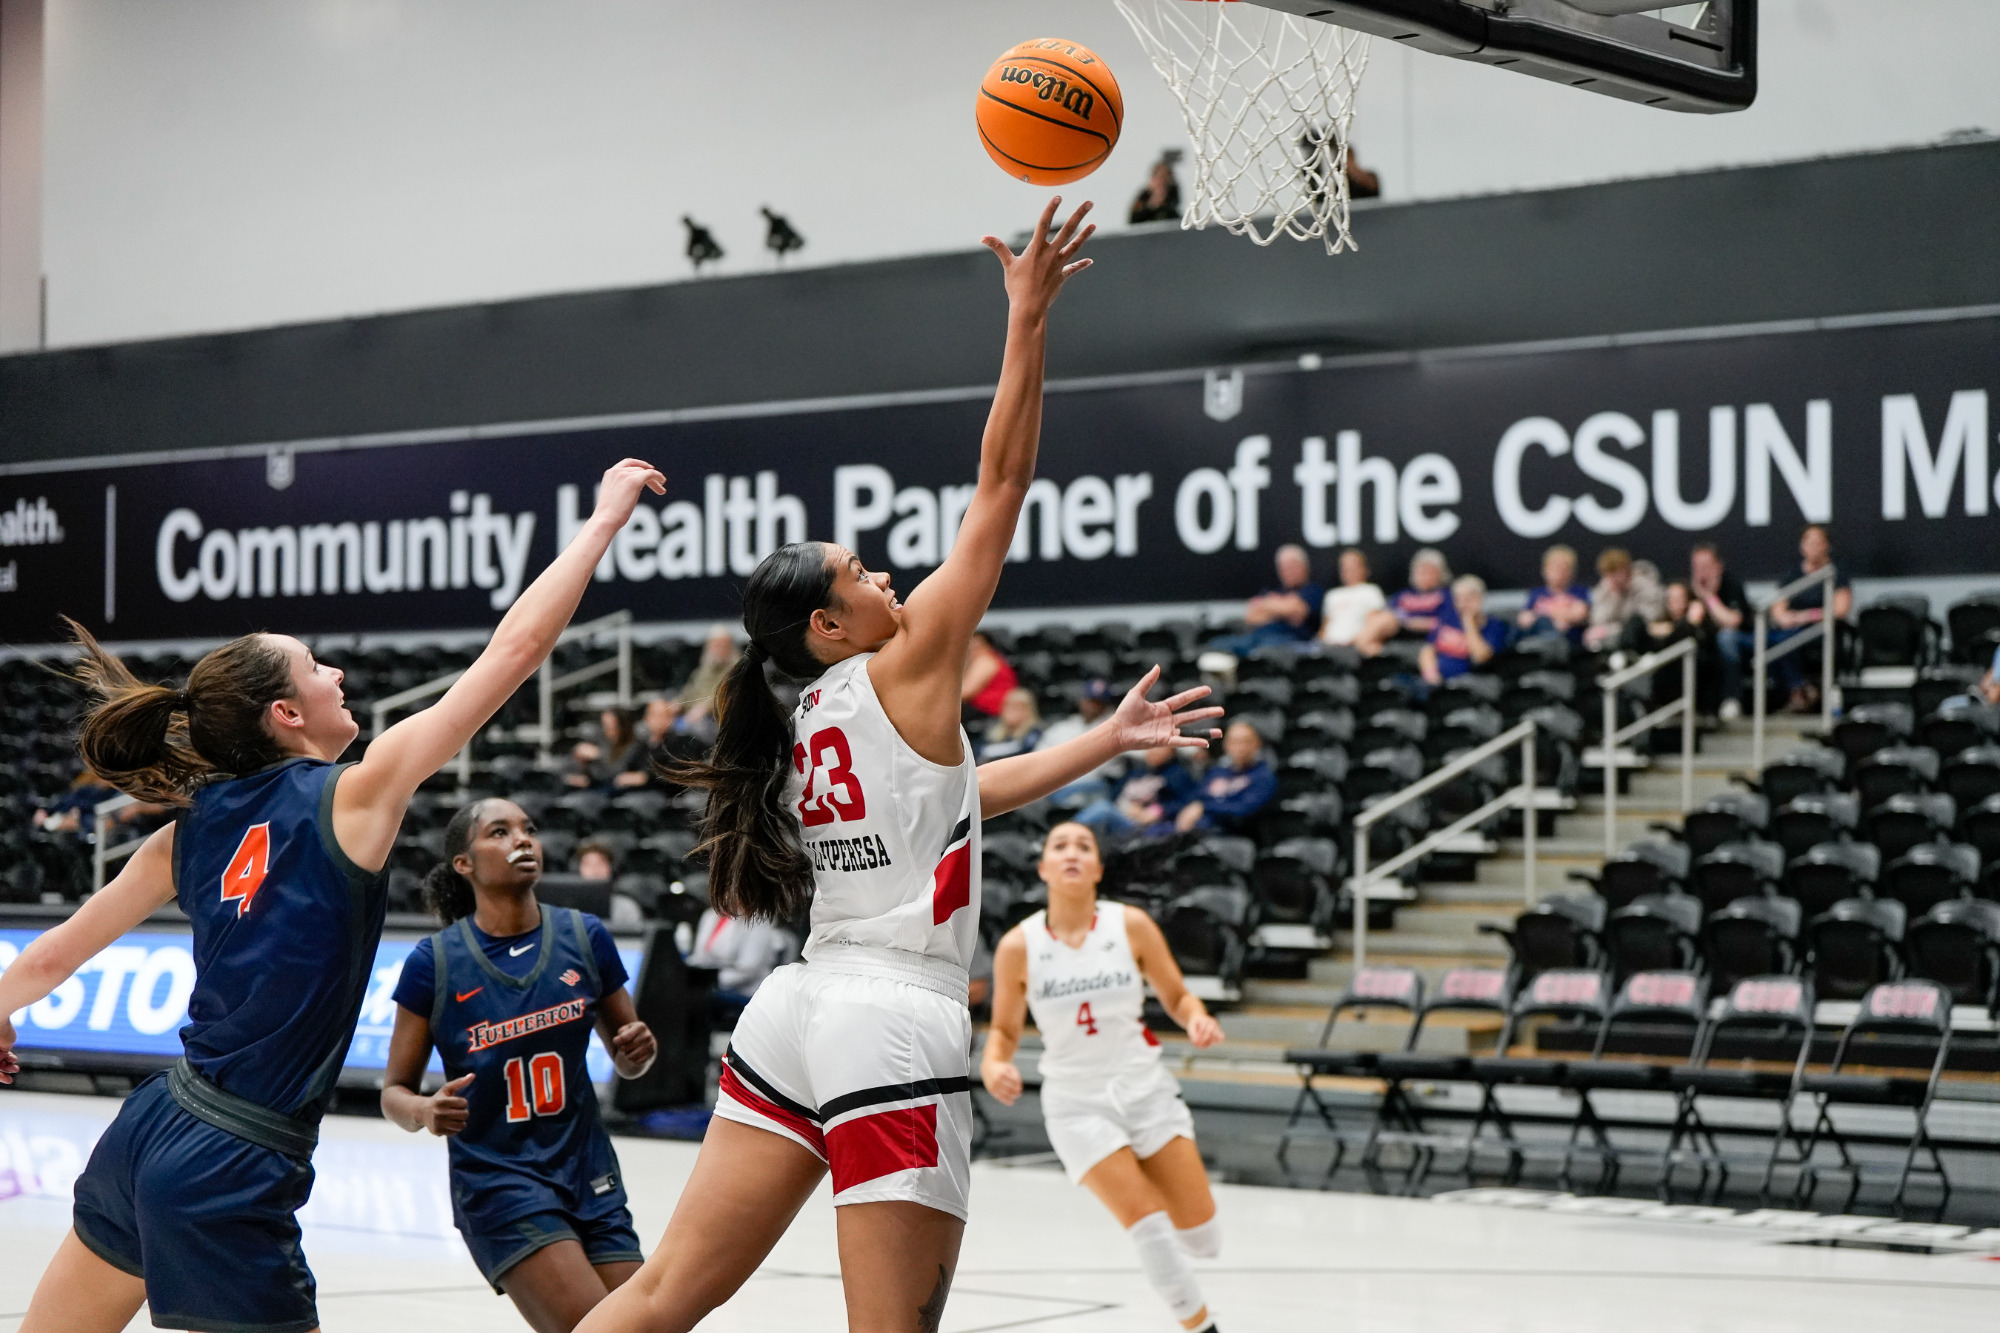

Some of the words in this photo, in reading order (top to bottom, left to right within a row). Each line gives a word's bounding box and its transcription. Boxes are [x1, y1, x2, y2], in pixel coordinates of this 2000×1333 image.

[1000, 65, 1095, 121] Wilson
[0, 495, 66, 546] alth.
[156, 490, 535, 610] Community
[833, 460, 1153, 569] Parner
[1175, 434, 1271, 553] of
[1294, 430, 1461, 546] the
[1493, 399, 1832, 538] CSUN
[1881, 388, 2000, 520] M
[220, 821, 270, 919] 4
[469, 999, 585, 1052] FULLERTON
[1076, 1002, 1098, 1037] 4
[503, 1051, 566, 1123] 10
